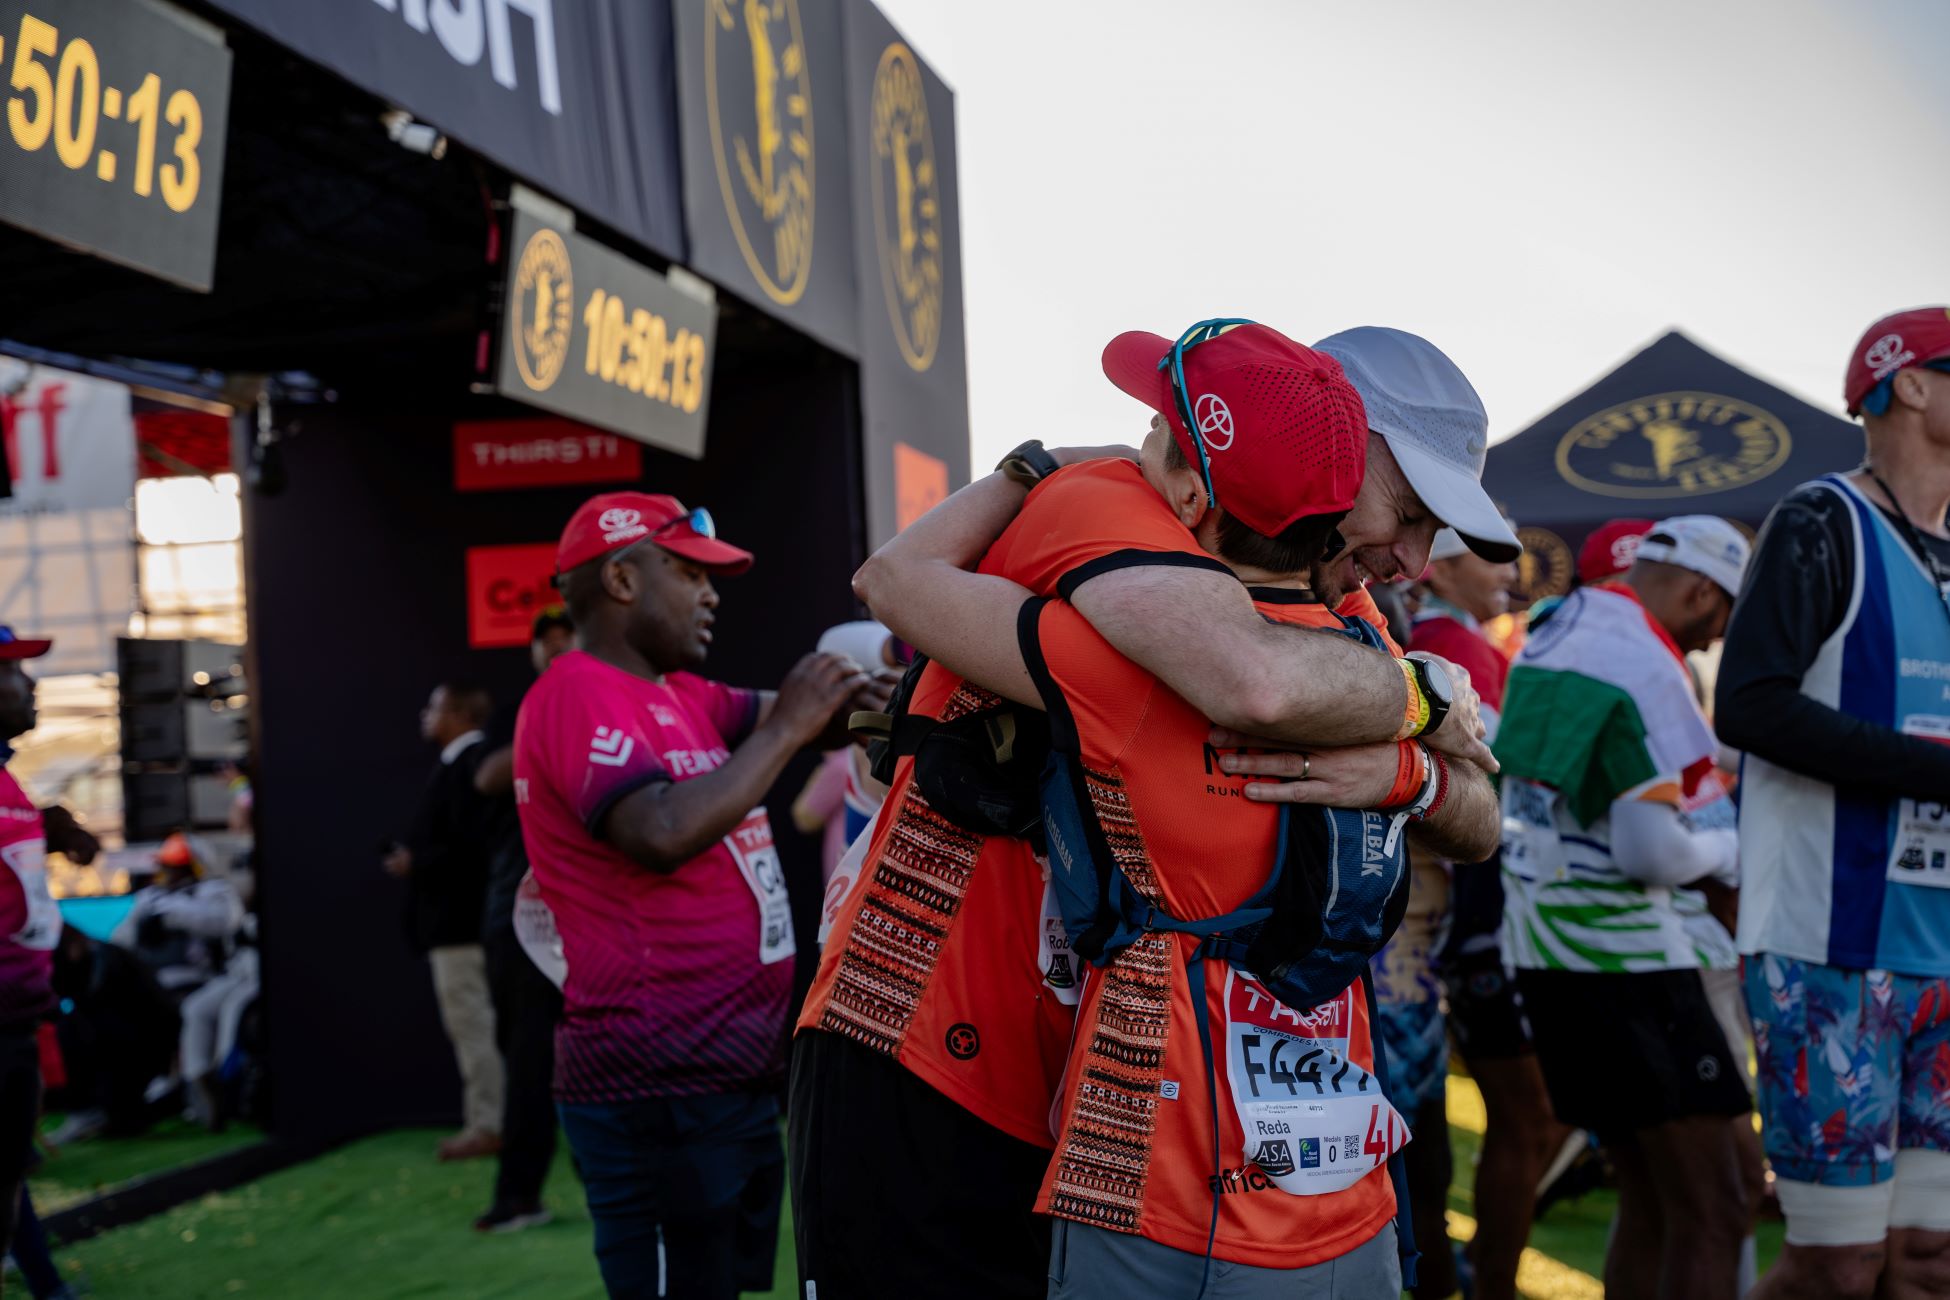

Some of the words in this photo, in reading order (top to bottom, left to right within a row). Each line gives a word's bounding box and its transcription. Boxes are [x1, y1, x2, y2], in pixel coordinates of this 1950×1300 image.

[0, 13, 203, 213] 50:13
[584, 287, 705, 414] 10:50:13
[1361, 811, 1384, 877] ELBAK
[1253, 1027, 1312, 1046] COMRADES
[1256, 1119, 1291, 1135] Reda
[1257, 1144, 1290, 1161] ASA
